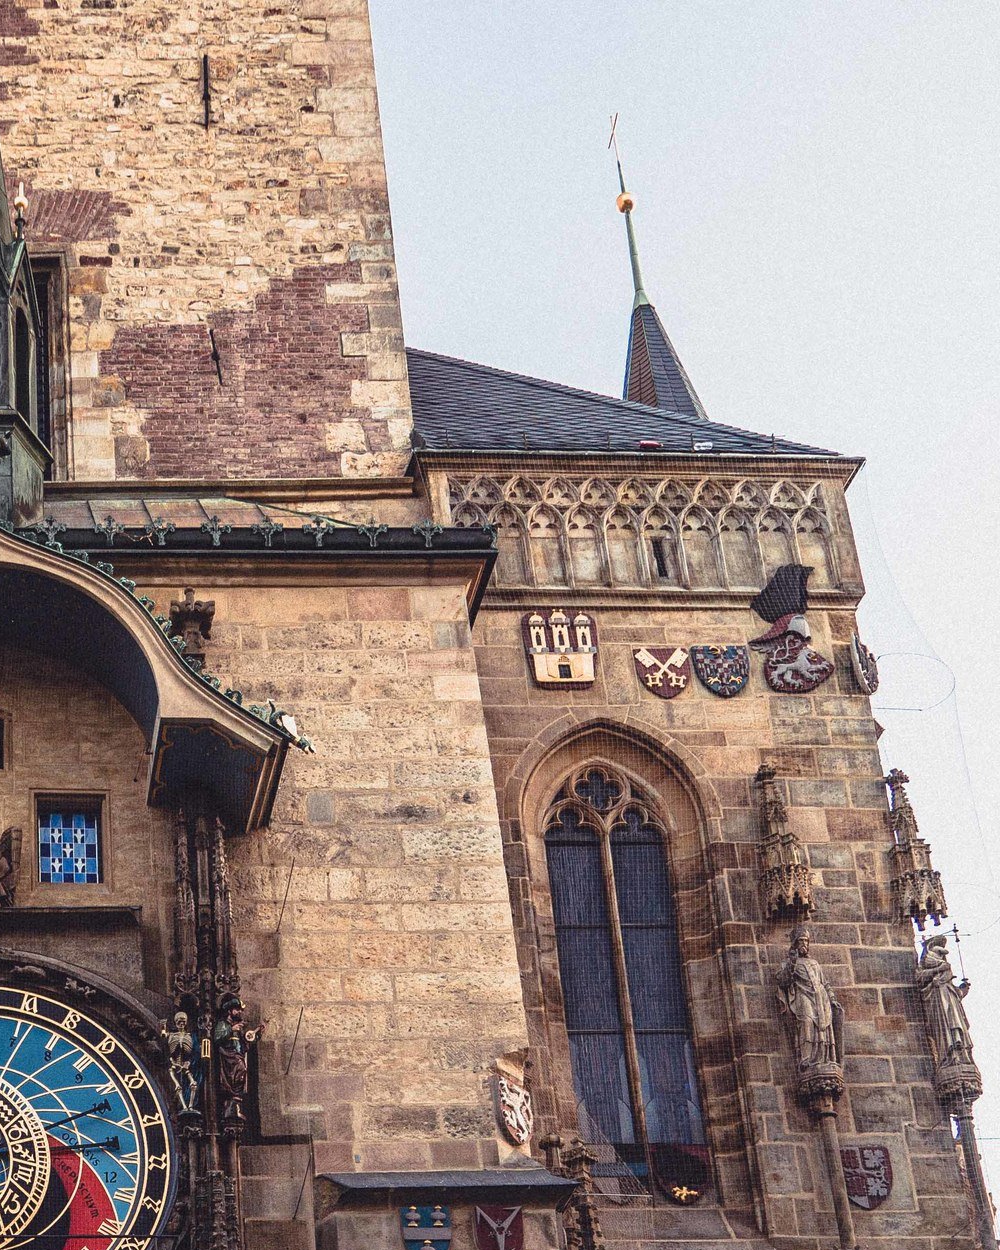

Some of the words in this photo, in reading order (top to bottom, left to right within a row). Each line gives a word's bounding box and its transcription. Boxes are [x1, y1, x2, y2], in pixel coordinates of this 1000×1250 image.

[9, 1036, 18, 1048] 7
[44, 1049, 52, 1061] 8
[72, 1052, 93, 1073] III
[75, 1073, 84, 1084] 9
[103, 1171, 118, 1184] 12
